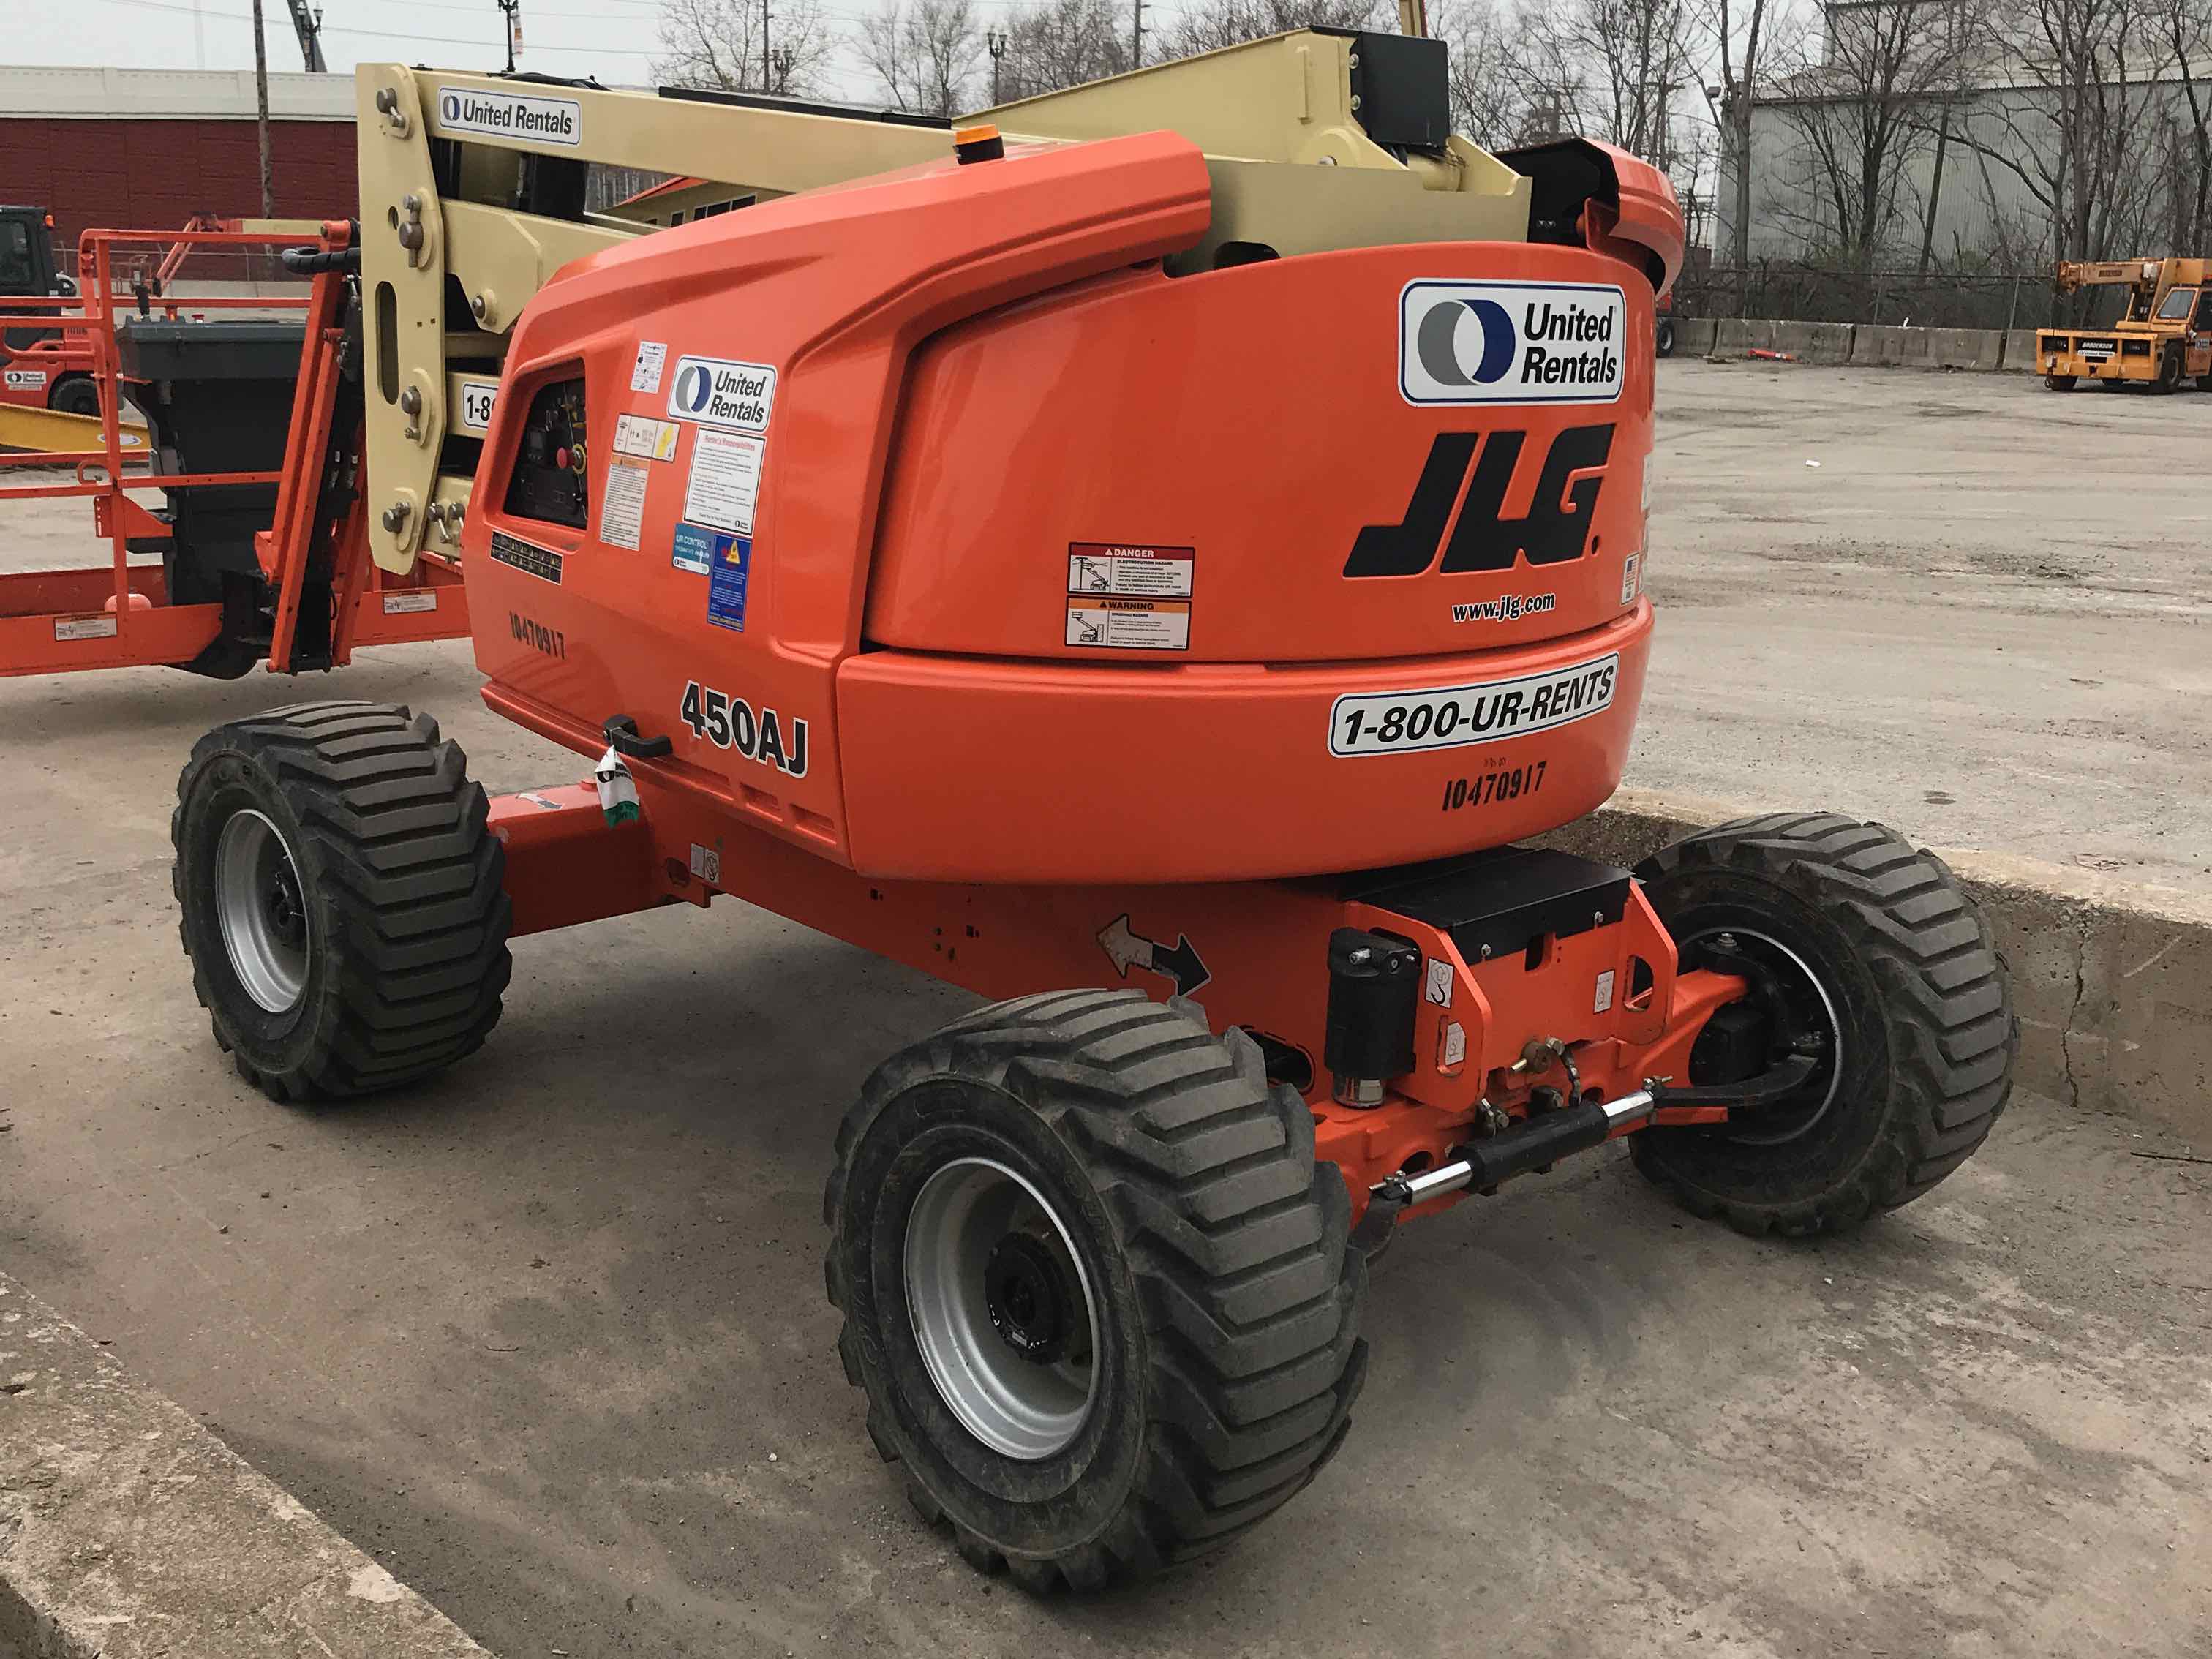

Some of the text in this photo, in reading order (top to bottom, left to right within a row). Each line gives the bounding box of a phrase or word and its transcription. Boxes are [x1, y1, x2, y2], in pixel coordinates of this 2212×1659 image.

[464, 99, 572, 135] United Rentals
[1524, 303, 1614, 342] United
[1521, 346, 1616, 384] Rentals
[715, 370, 767, 398] United
[467, 394, 496, 421] 1-8
[709, 395, 765, 424] Rentals
[1114, 549, 1154, 557] DANGER
[1109, 601, 1154, 610] WARNING
[1453, 594, 1555, 622] www.jlg.com
[1344, 666, 1614, 745] 1-800-UR-RENTS
[681, 680, 808, 779] 450AJ
[1442, 761, 1546, 811] 10470917
